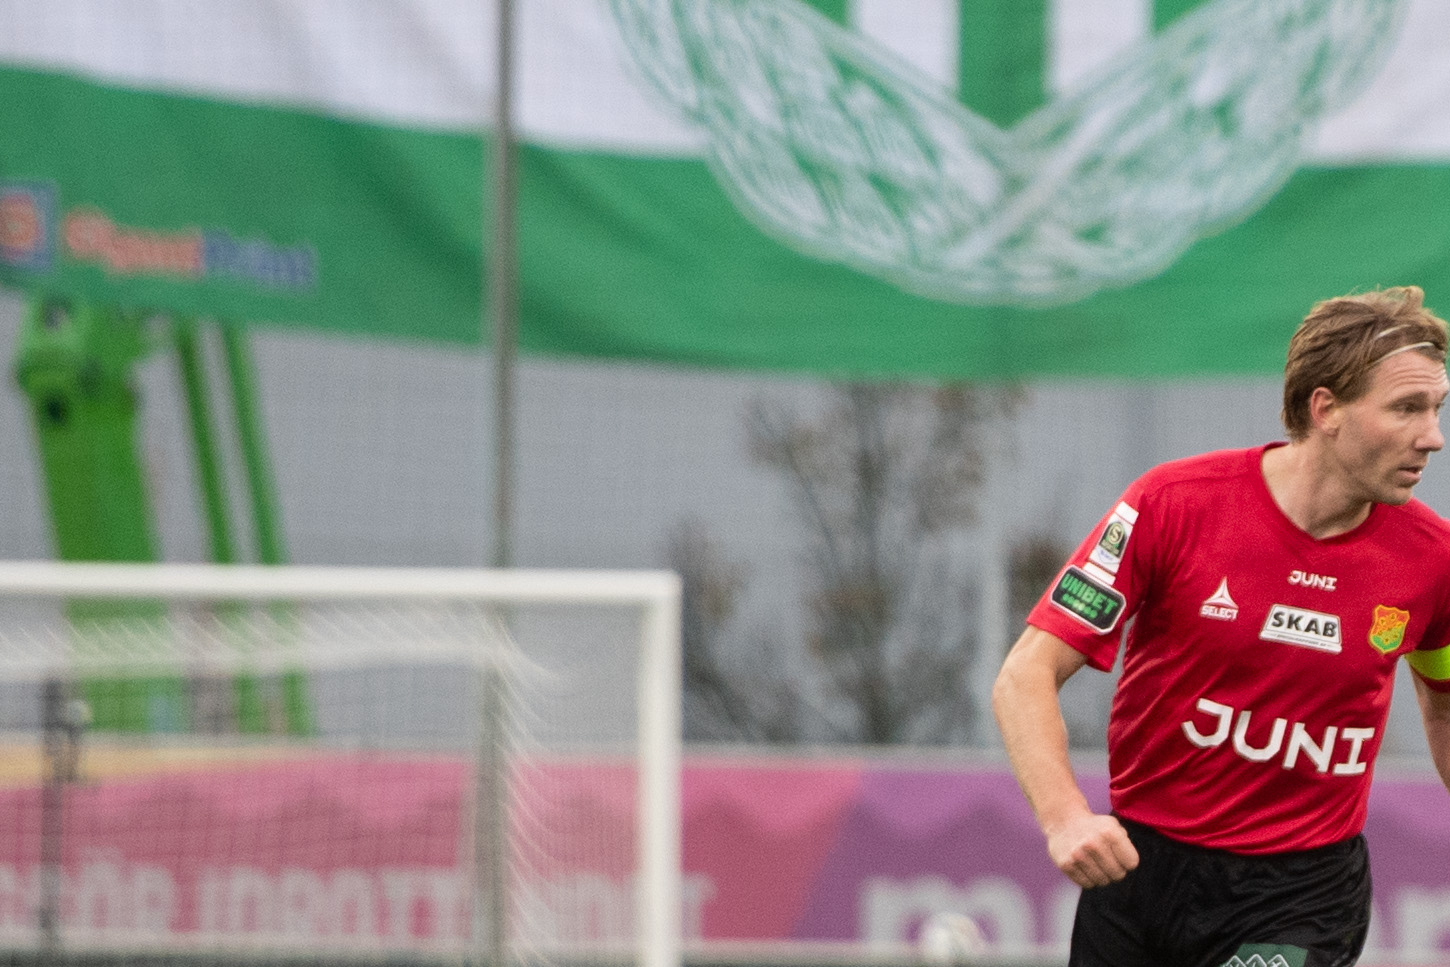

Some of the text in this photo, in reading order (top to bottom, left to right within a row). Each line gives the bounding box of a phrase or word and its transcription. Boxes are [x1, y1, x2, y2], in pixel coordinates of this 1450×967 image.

[1289, 570, 1337, 590] JUNI
[1061, 573, 1118, 615] UNIBET
[1201, 604, 1239, 619] SELECT
[1271, 611, 1338, 638] SKAB
[1181, 697, 1376, 776] JUNI
